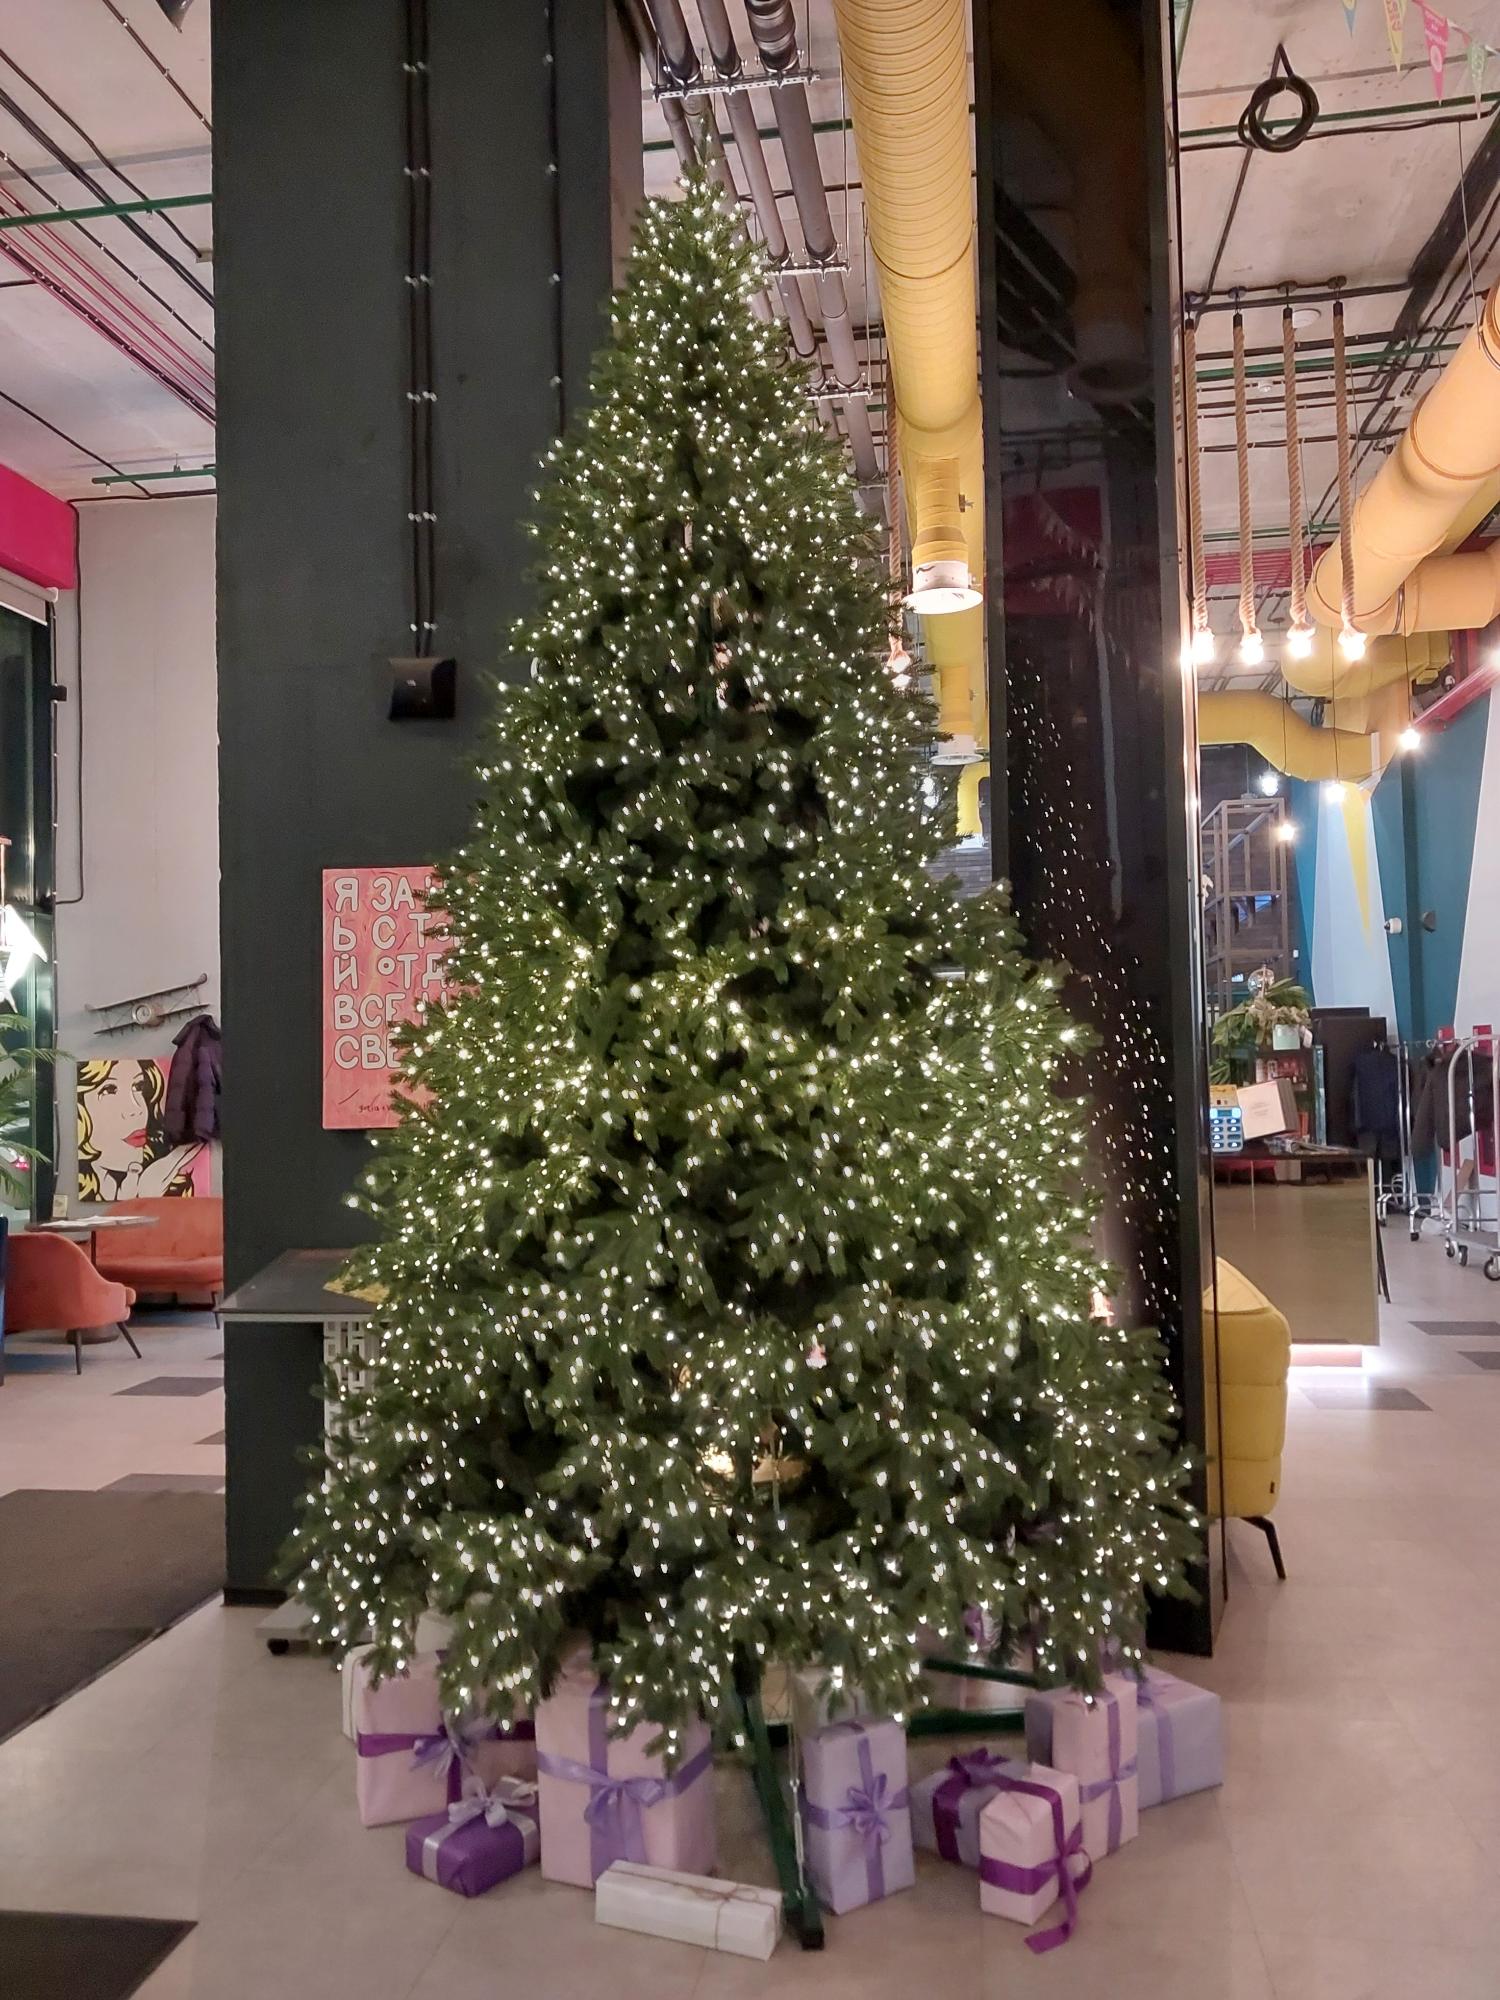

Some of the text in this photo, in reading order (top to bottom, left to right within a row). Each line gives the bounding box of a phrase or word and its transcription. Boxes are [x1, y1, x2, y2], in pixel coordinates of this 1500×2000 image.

[334, 876, 359, 912] Я
[371, 876, 416, 912] ЗА
[332, 915, 358, 952] Ь
[371, 914, 397, 951] С
[333, 953, 455, 991] Й ОТД
[334, 1034, 401, 1070] СВЕ
